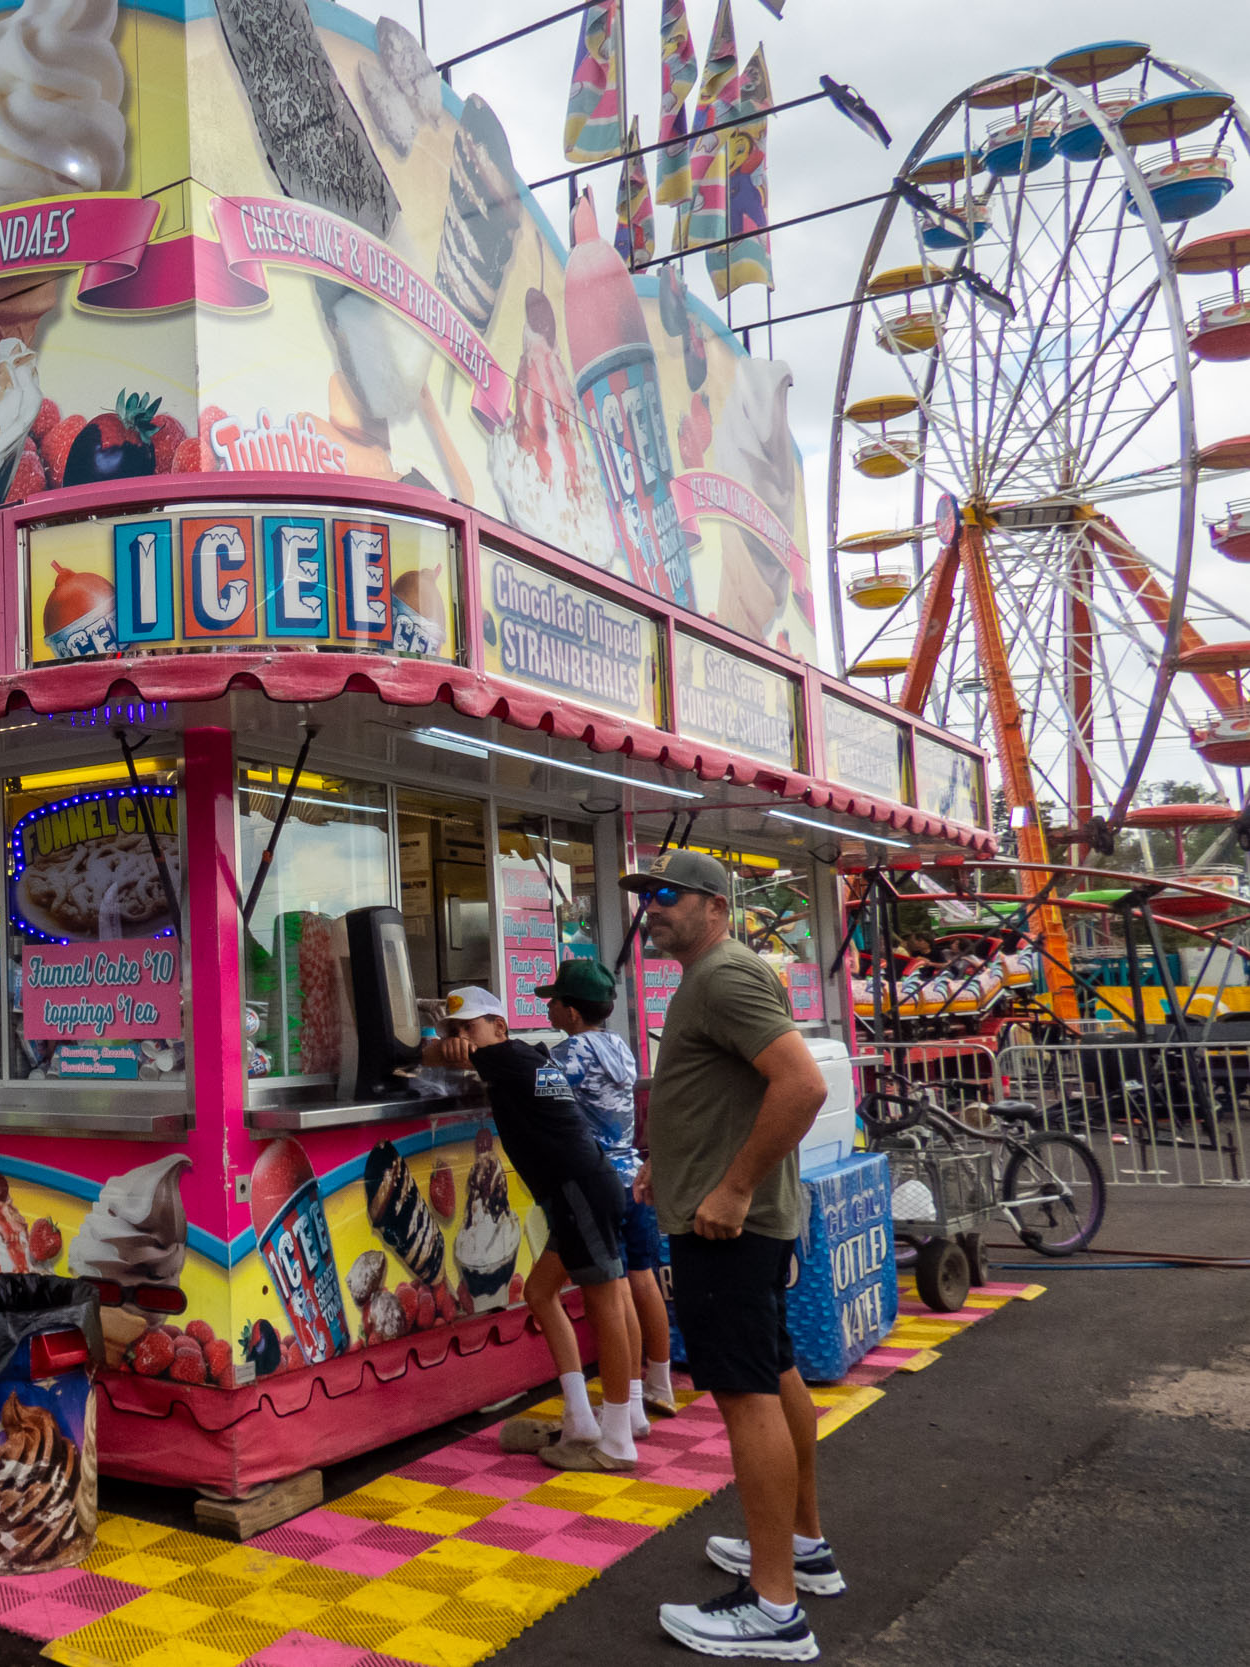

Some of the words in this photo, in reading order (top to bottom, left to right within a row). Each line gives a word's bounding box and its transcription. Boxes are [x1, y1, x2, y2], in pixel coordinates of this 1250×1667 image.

[240, 204, 345, 269] CHEESECAKE
[349, 234, 364, 278] &
[367, 243, 405, 300] DEEP
[408, 274, 448, 338] FRIED
[449, 314, 493, 389] TREATS
[214, 412, 347, 475] Twinkies
[132, 523, 390, 634] ICEE
[495, 563, 585, 637] Chocolate
[587, 602, 640, 659] Dipped
[502, 618, 640, 707] STRAWBERRIES
[705, 651, 732, 691] Soft
[733, 662, 766, 707] Serve
[679, 684, 724, 735] CONES
[738, 705, 790, 756] SUNDAES
[21, 799, 119, 867] FUNNEL
[504, 915, 529, 946] Magic
[529, 916, 556, 947] Money
[28, 955, 92, 988] Funnel
[94, 952, 140, 985] Cake
[143, 948, 174, 983] $10
[510, 955, 533, 974] Thank
[516, 977, 537, 996] Hav
[44, 996, 114, 1035] toppings
[117, 993, 133, 1024] $1
[134, 1002, 159, 1024] ea
[515, 997, 534, 1016] Nice
[268, 1200, 329, 1300] ICEE
